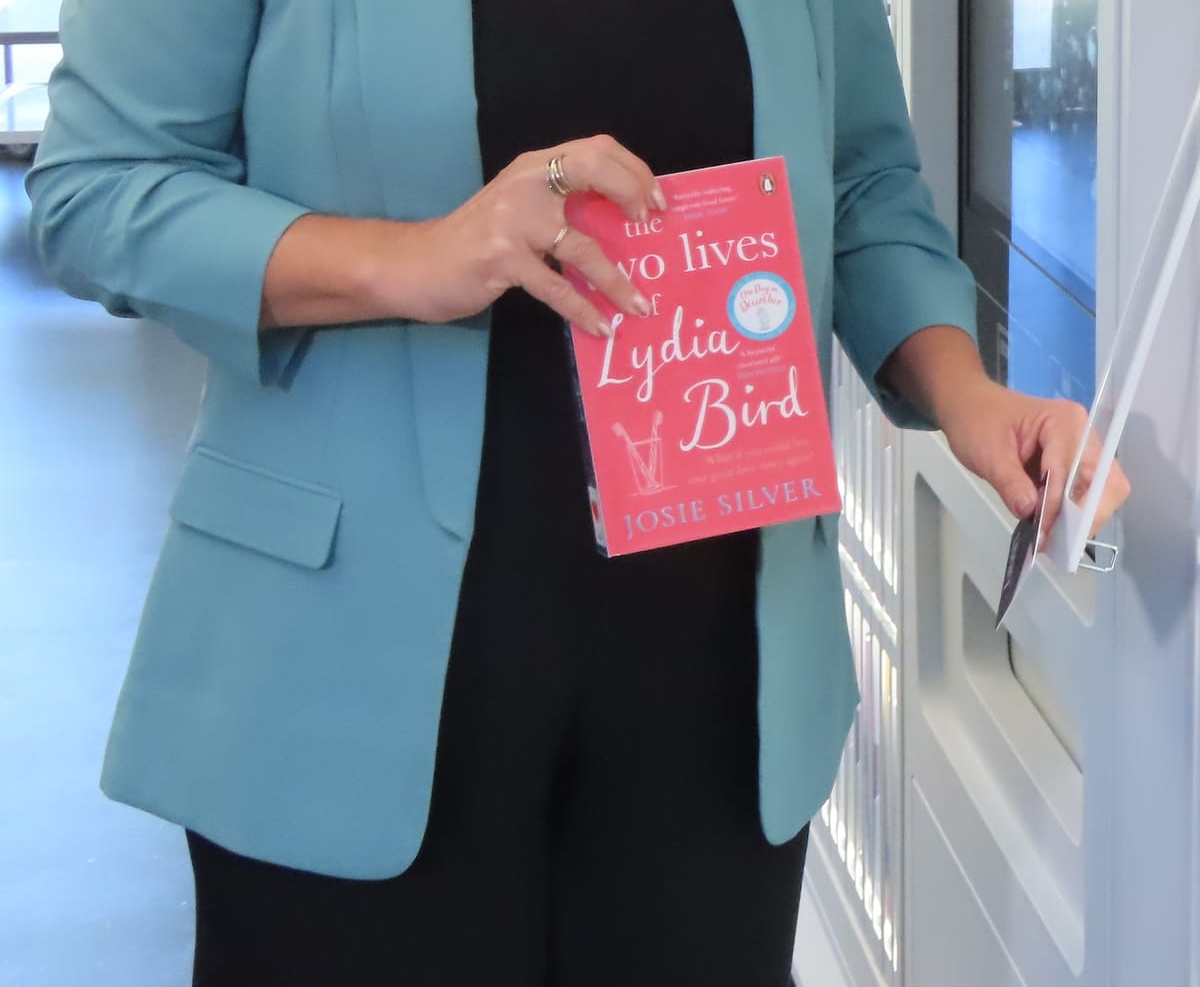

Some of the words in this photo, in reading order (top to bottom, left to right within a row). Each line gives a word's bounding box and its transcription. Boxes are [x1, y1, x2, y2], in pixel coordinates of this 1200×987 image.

[616, 253, 666, 283] wo
[679, 230, 779, 273] lives
[624, 217, 664, 240] the
[596, 305, 741, 404] Lydia
[680, 365, 808, 452] Bird
[624, 498, 705, 540] JOSIE
[718, 477, 823, 517] SILVER
